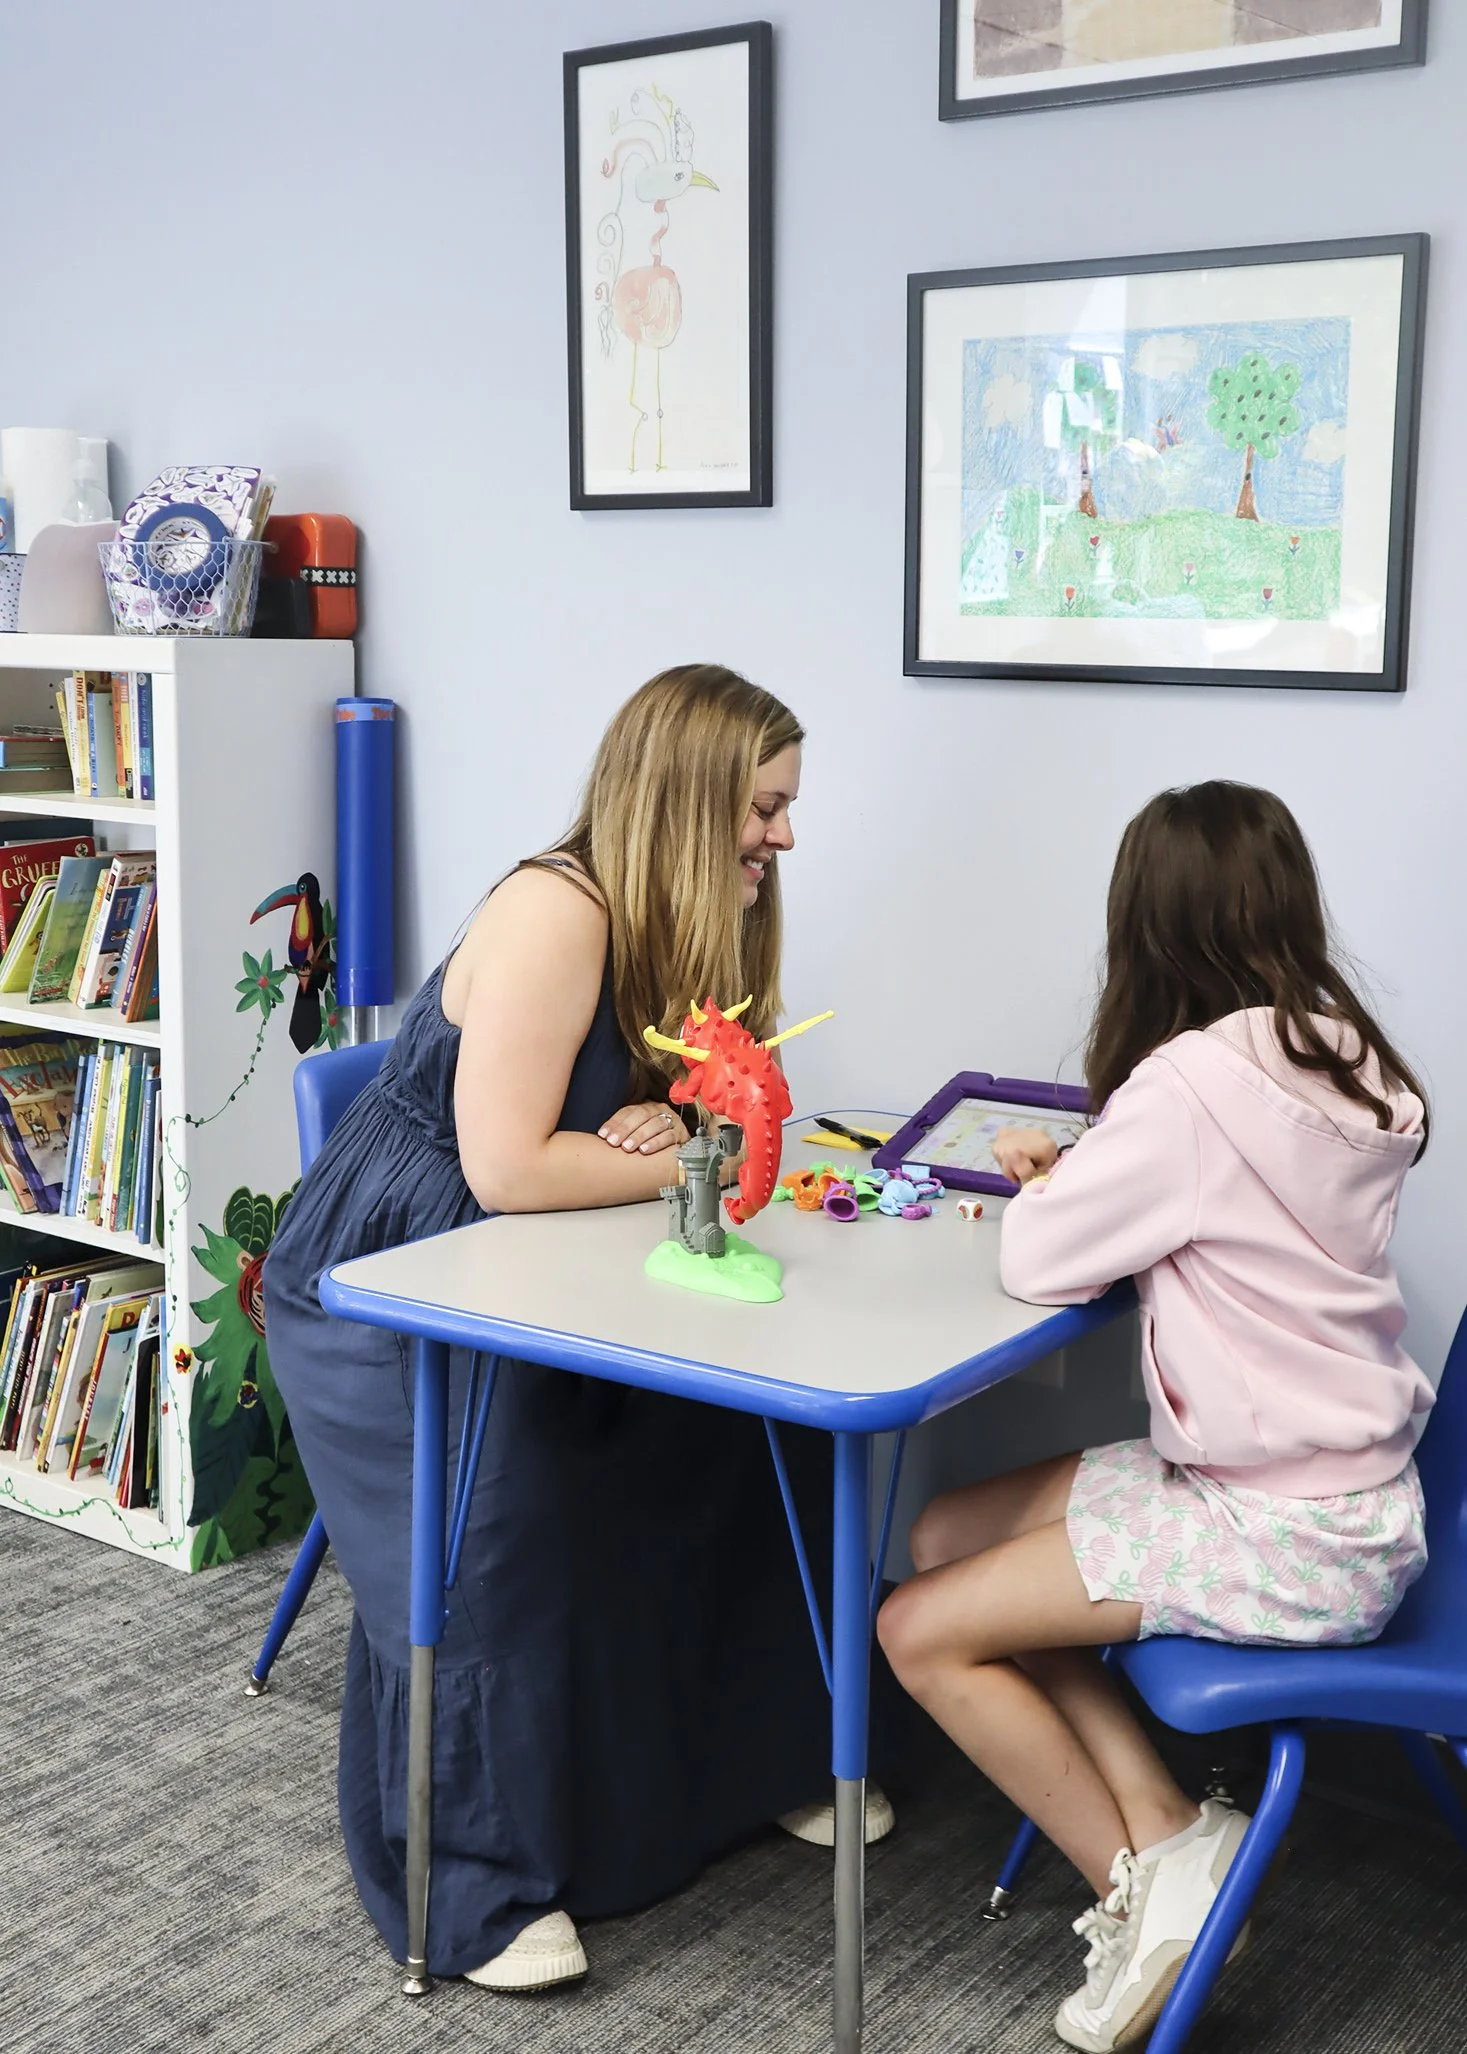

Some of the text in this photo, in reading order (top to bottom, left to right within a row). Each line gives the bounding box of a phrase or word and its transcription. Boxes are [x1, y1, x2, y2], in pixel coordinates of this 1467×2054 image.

[76, 677, 85, 705] DON'T
[10, 854, 27, 866] THE
[121, 928, 135, 964] BUBBLES
[84, 1378, 97, 1421] JOURNEY
